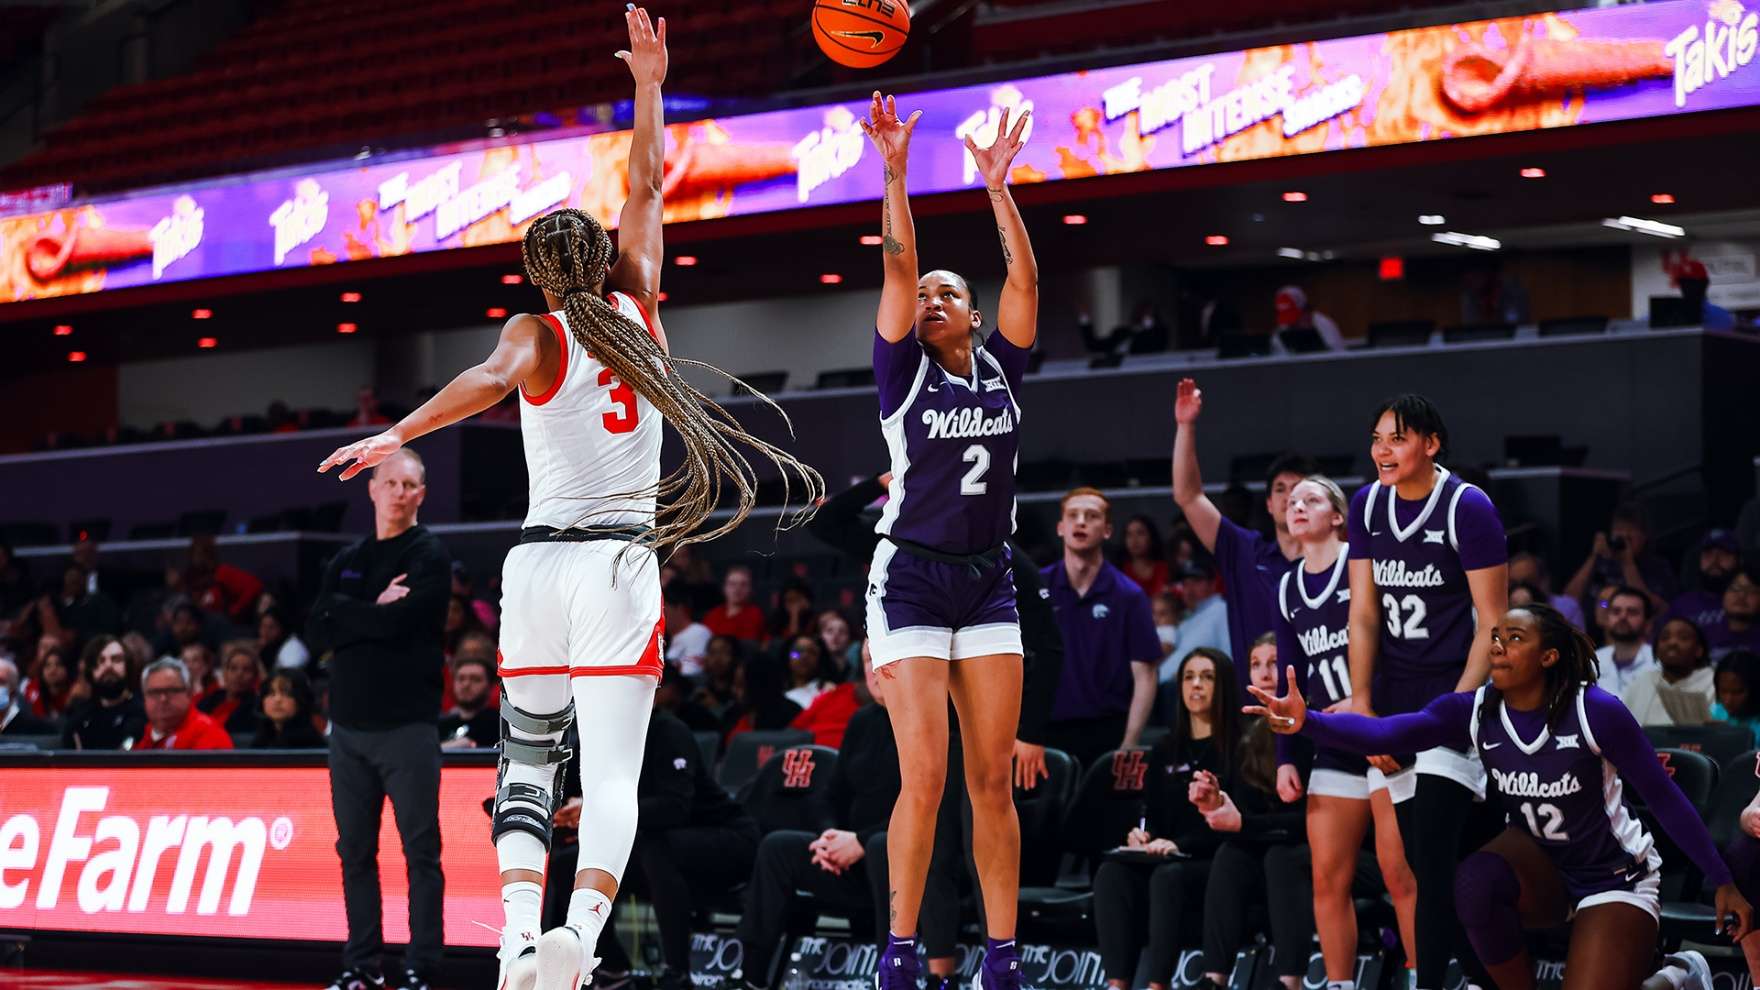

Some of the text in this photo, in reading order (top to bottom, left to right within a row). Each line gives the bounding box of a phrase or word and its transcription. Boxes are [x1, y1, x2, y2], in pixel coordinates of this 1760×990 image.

[1665, 12, 1759, 108] Takis
[597, 367, 640, 435] 3
[922, 406, 1013, 439] Wildcats
[960, 444, 991, 496] 2
[1372, 559, 1445, 588] Wildcats
[1382, 593, 1430, 639] 32
[1297, 625, 1350, 656] Wildca
[1318, 655, 1352, 701] 11
[1491, 768, 1582, 798] Wildcats
[1520, 802, 1570, 841] 12
